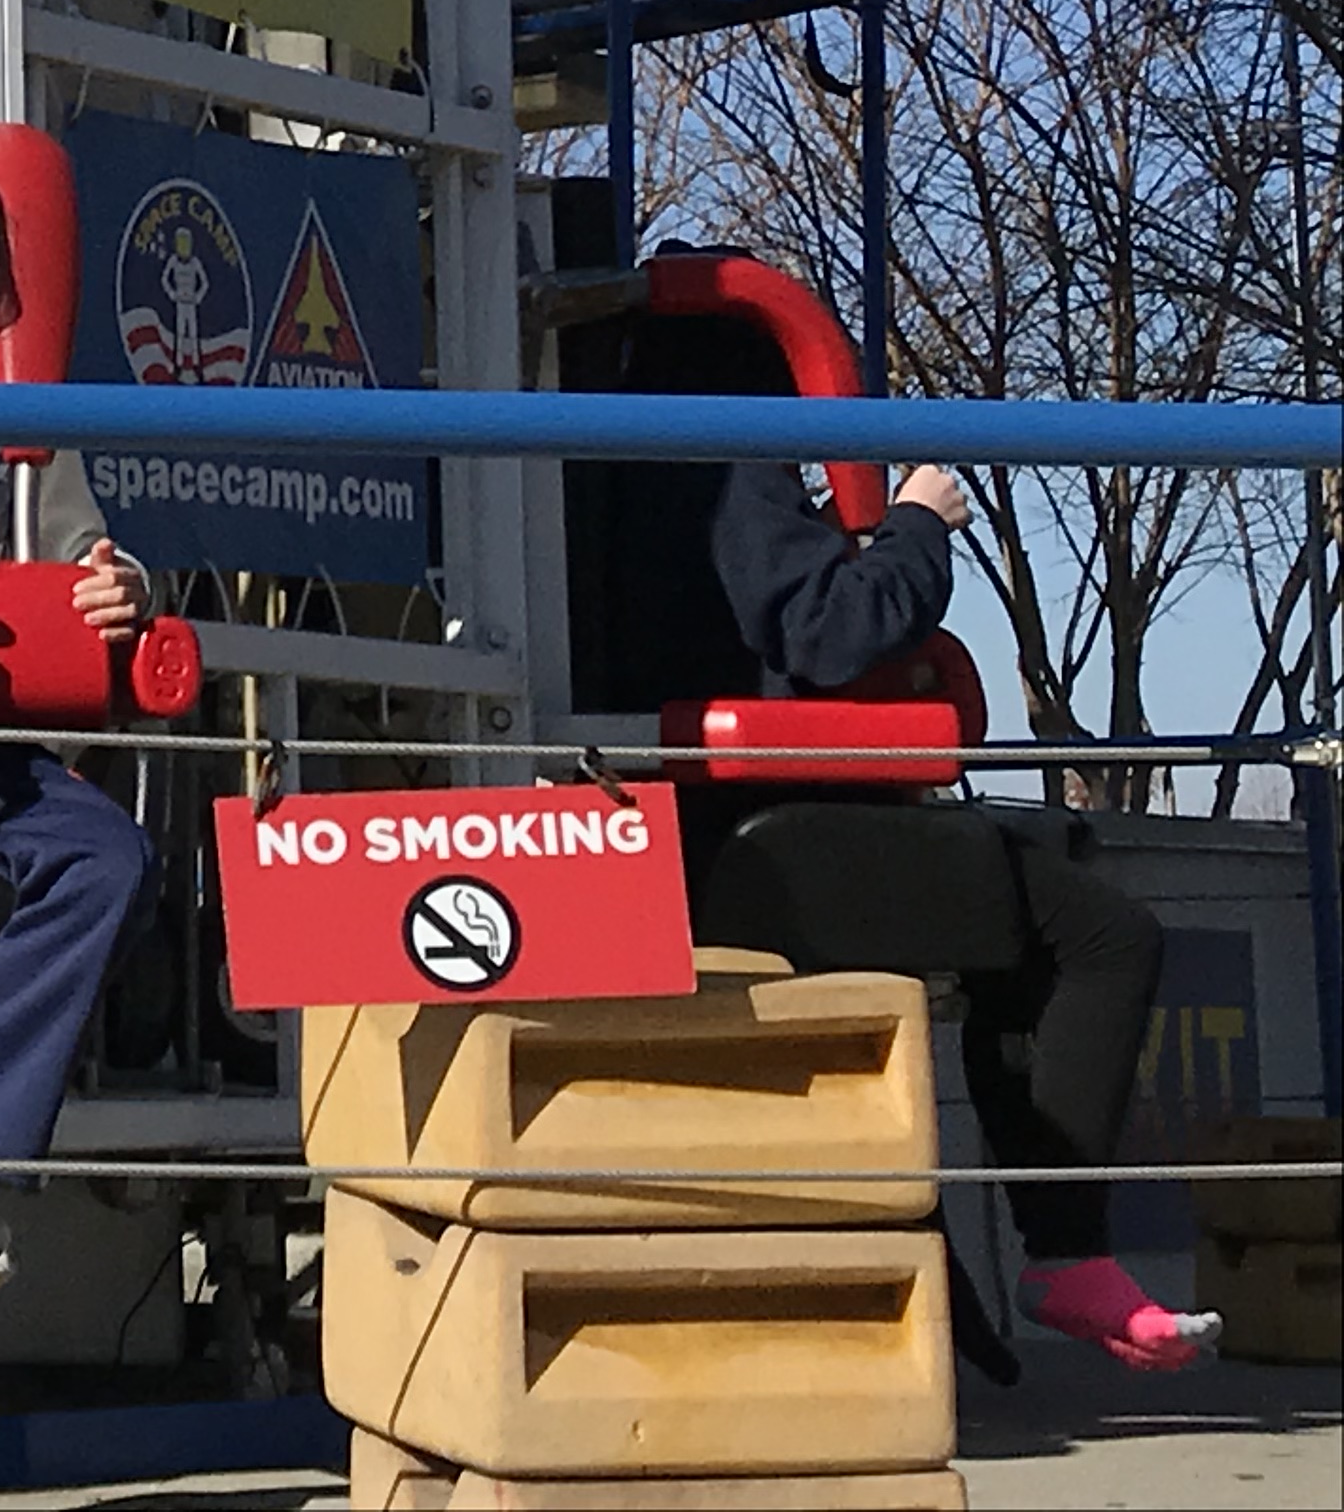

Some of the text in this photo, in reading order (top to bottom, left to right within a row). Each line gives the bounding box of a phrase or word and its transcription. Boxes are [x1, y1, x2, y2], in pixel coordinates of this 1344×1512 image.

[133, 191, 239, 268] SPACE CAMP
[267, 361, 363, 389] AVIATION
[93, 455, 413, 525] spacecamp.com
[255, 809, 650, 867] NO SMOKING
